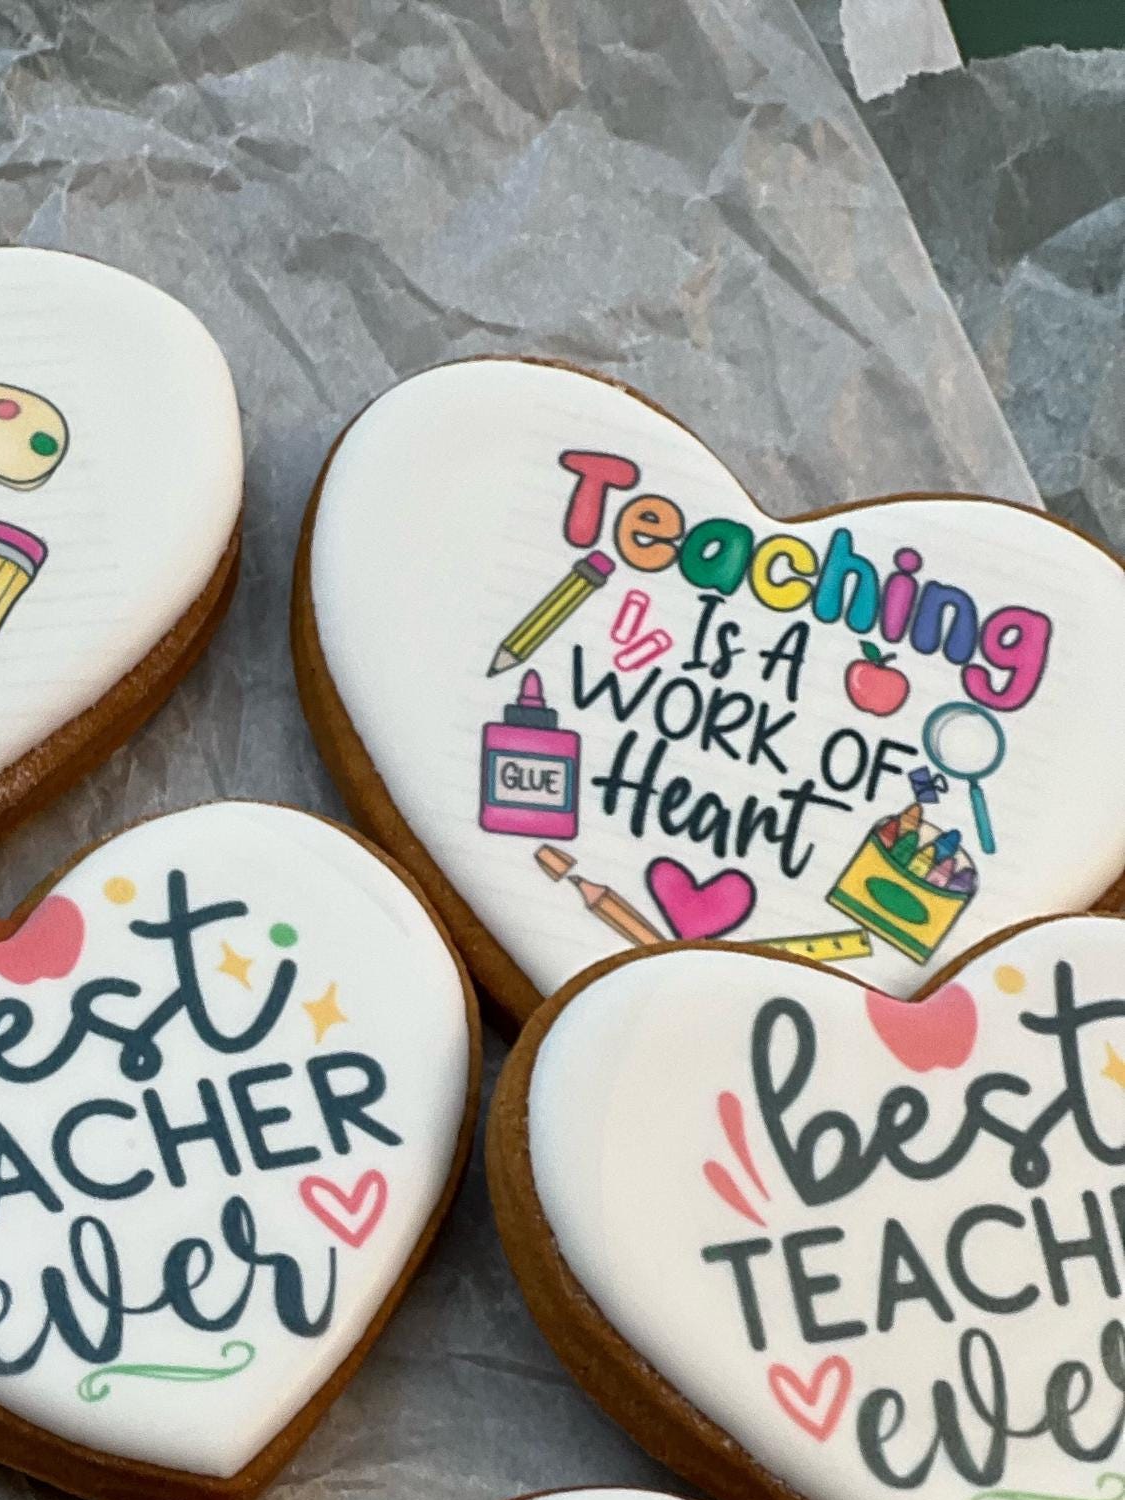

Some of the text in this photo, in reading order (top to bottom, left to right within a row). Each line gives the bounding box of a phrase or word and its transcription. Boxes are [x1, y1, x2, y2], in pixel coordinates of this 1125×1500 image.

[559, 450, 1052, 712] Teaching
[682, 594, 810, 703] Is A
[499, 760, 561, 795] GLUE
[571, 645, 918, 801] WORK OF
[592, 730, 853, 879] Heart
[701, 1183, 1125, 1352] TEACH
[855, 1319, 1125, 1490] eve
